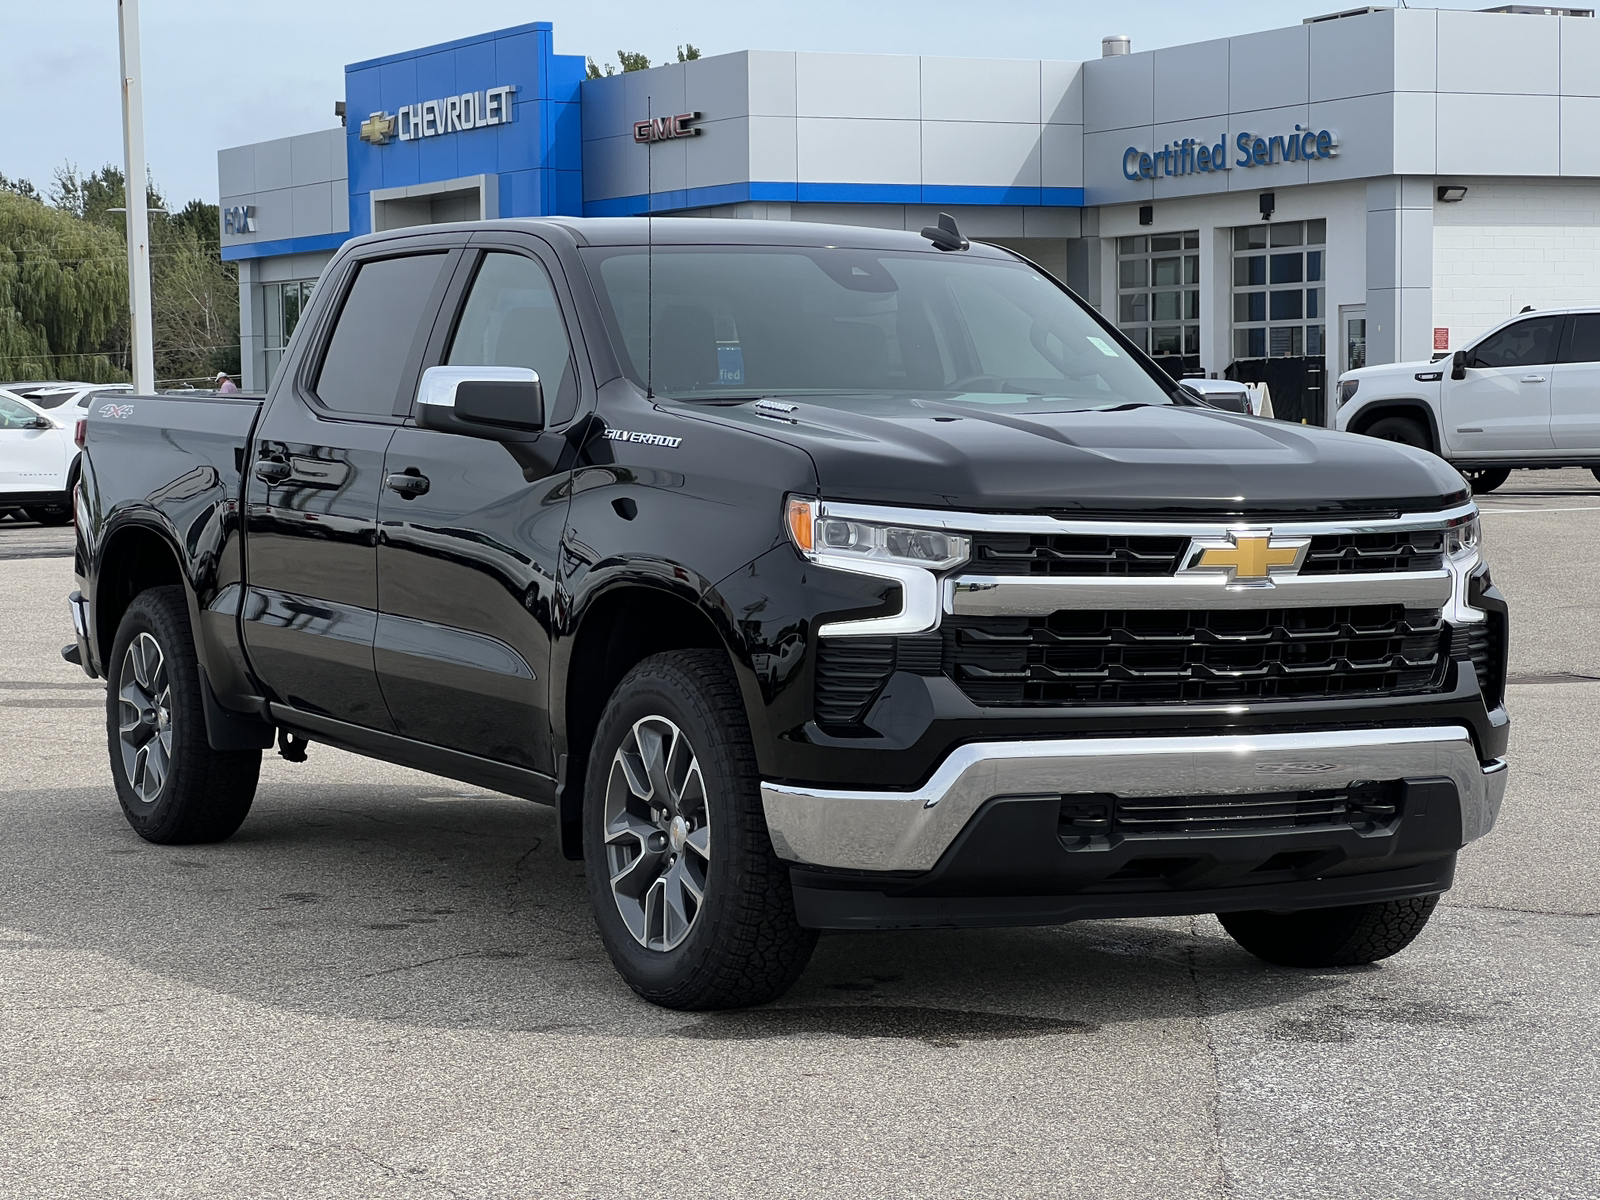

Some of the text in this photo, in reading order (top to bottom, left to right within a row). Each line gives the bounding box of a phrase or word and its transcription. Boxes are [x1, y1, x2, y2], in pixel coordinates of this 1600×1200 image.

[398, 85, 514, 141] CHEVROLET
[633, 111, 699, 143] GMC
[1122, 124, 1337, 181] Certified Service
[224, 205, 256, 234] FOX
[602, 428, 682, 448] SILVERADO
